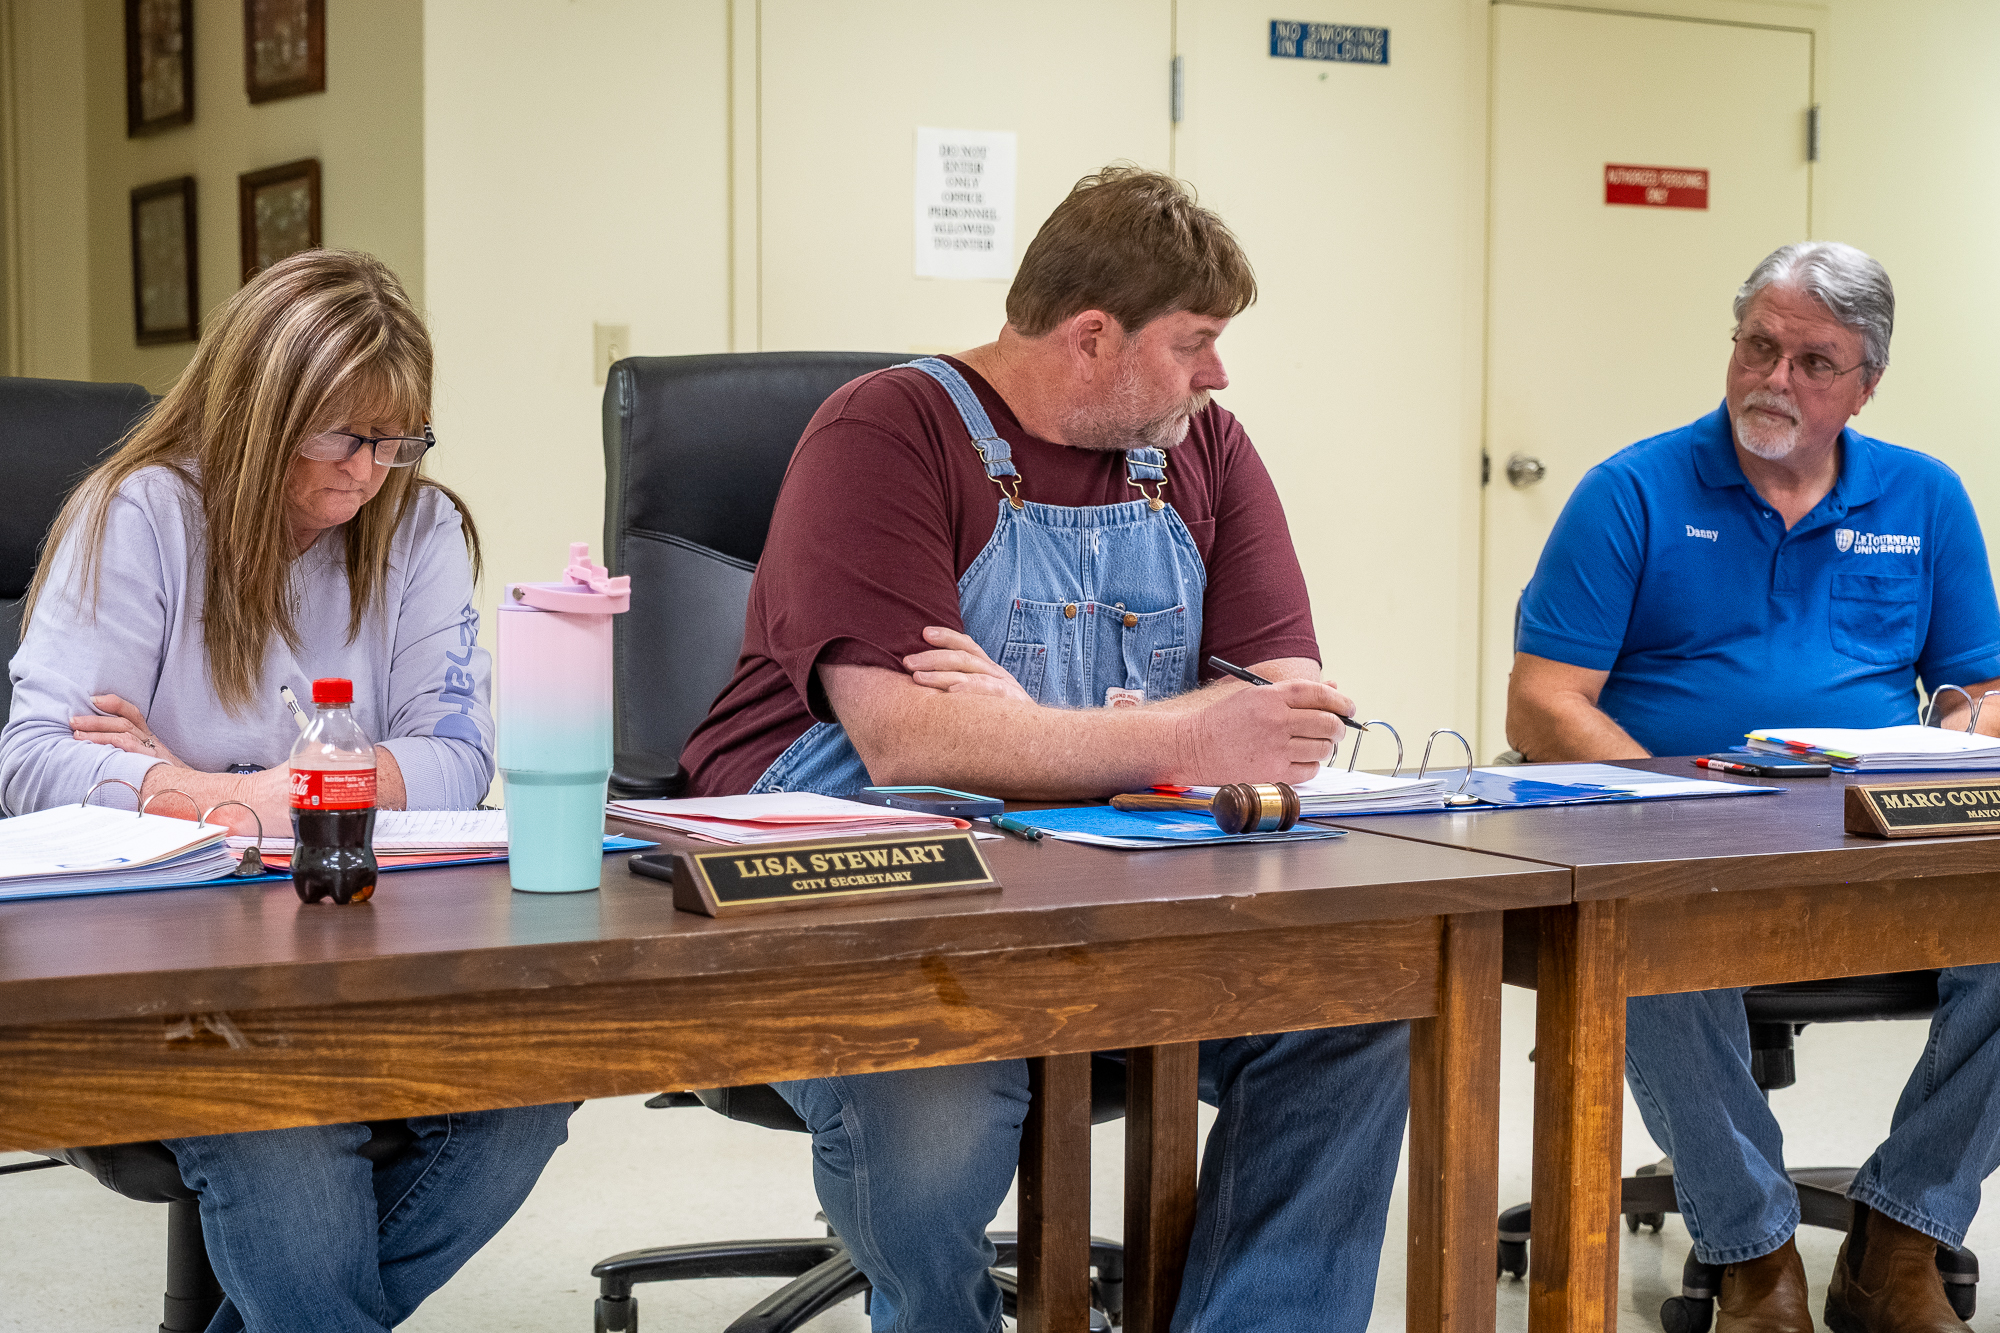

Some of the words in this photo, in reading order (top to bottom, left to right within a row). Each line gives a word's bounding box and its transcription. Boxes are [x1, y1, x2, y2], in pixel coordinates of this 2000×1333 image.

[1276, 21, 1301, 40] NO
[1307, 23, 1384, 46] SMOKING
[1278, 39, 1296, 57] IN
[1303, 40, 1382, 62] BUILDING
[943, 160, 983, 173] ENTER
[946, 176, 979, 188] ONLY
[928, 206, 998, 220] PERSONNEL
[954, 238, 993, 251] ENTER
[1685, 524, 1719, 542] Danny
[1853, 544, 1920, 555] UNIVERSITY
[1880, 792, 1946, 809] MARC
[1965, 809, 2000, 819] MAYO
[734, 856, 808, 878] LISA
[809, 844, 946, 873] STEWART
[792, 877, 827, 891] CITY
[829, 871, 913, 888] SECRETARY
